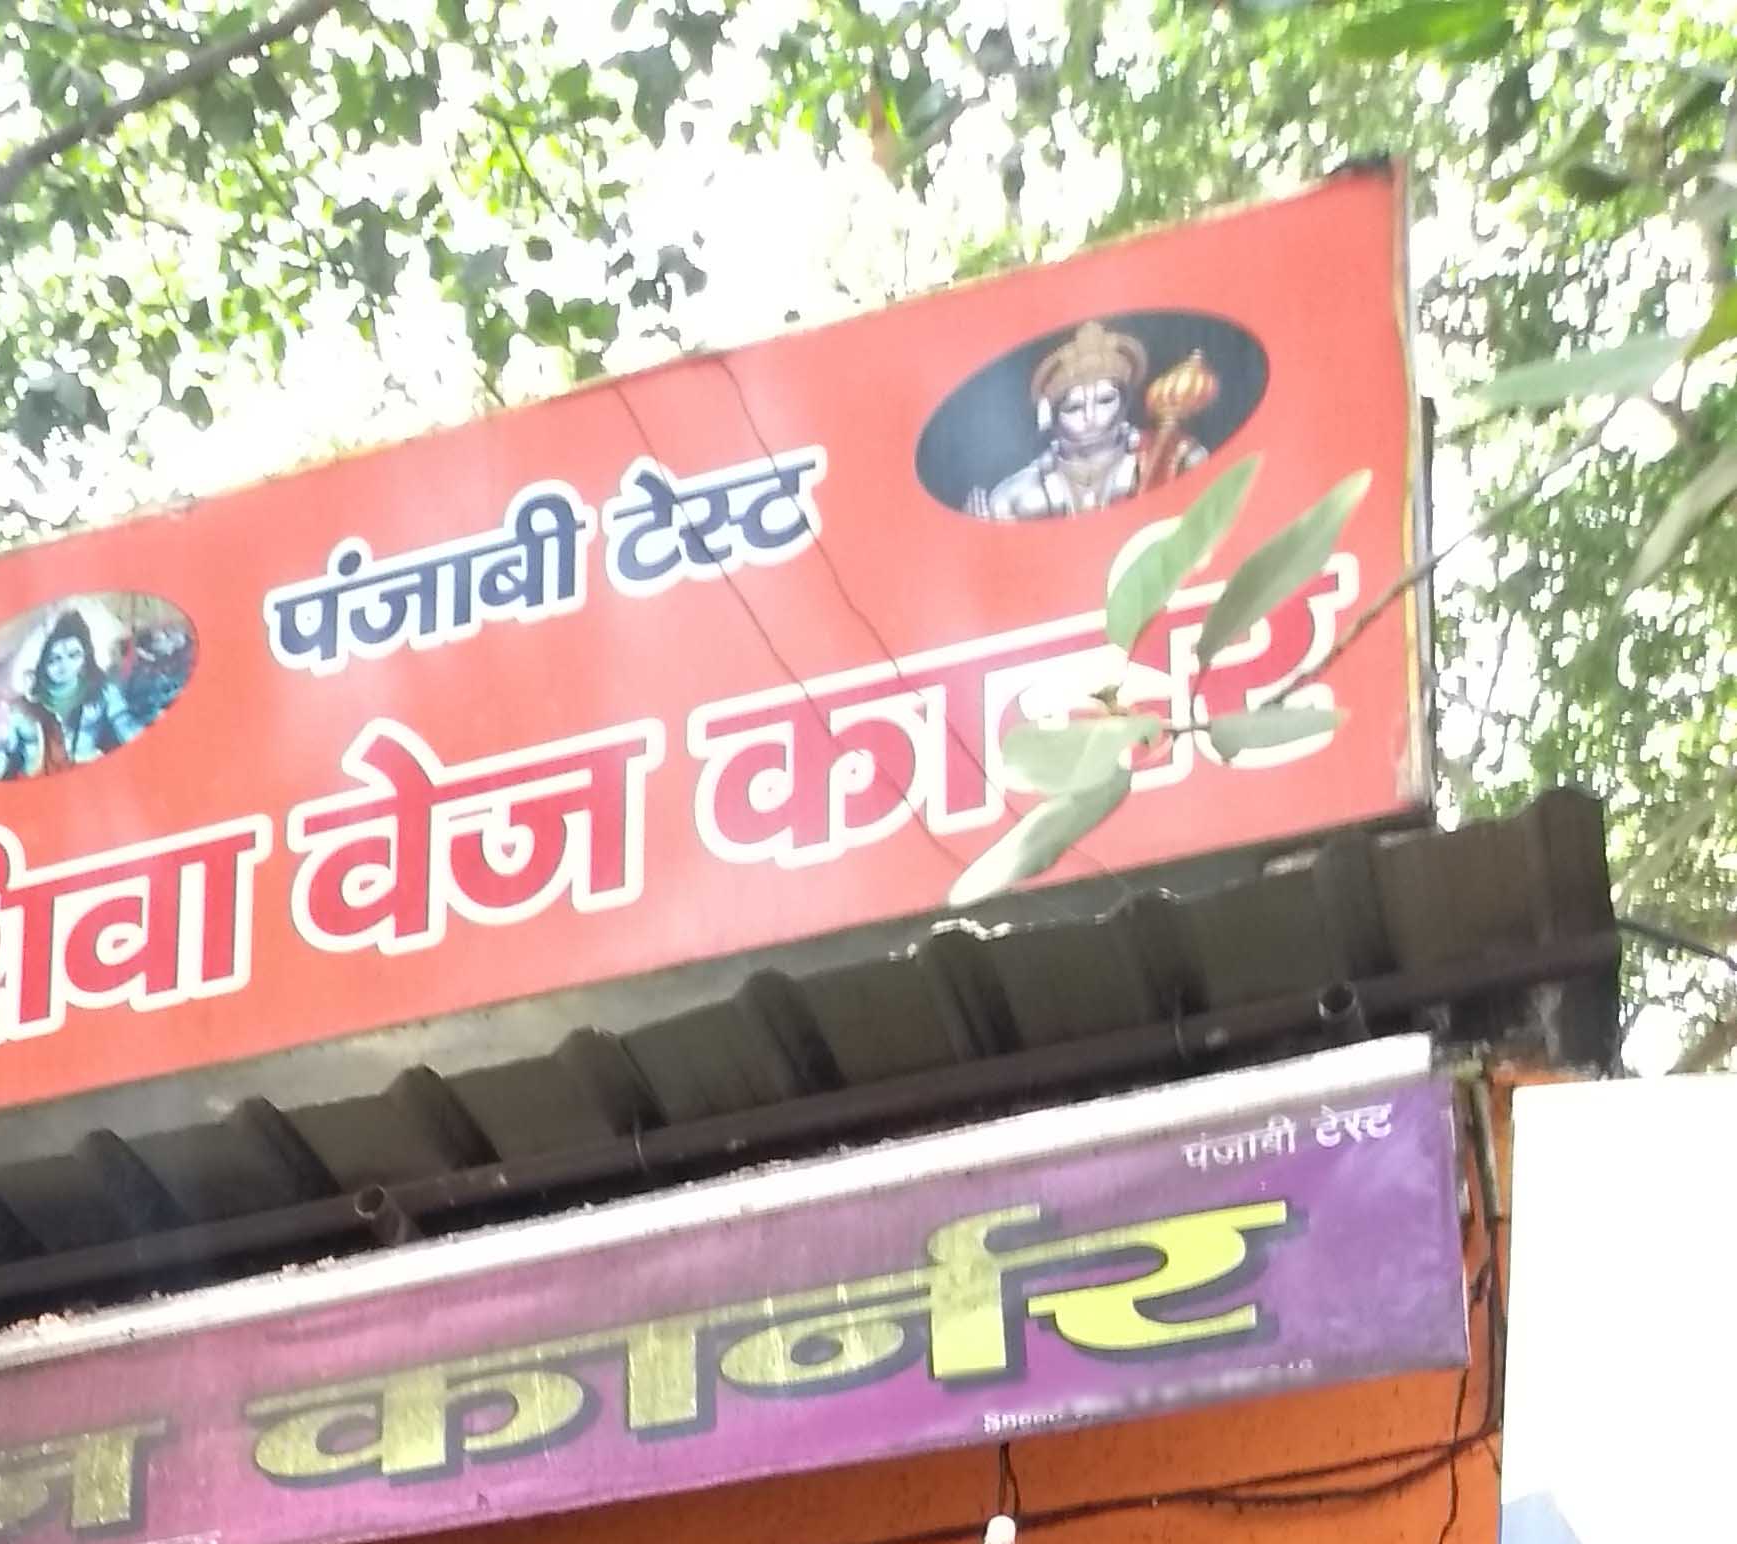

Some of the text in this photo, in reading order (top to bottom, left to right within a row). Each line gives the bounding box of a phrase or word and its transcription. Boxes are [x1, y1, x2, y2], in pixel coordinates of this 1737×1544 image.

[269, 448, 827, 668] पंजाबी टेस्ट
[290, 718, 664, 956] वेज
[1182, 1103, 1393, 1172] पंजाबी टेस्ट
[245, 1204, 1287, 1478] कार्नर
